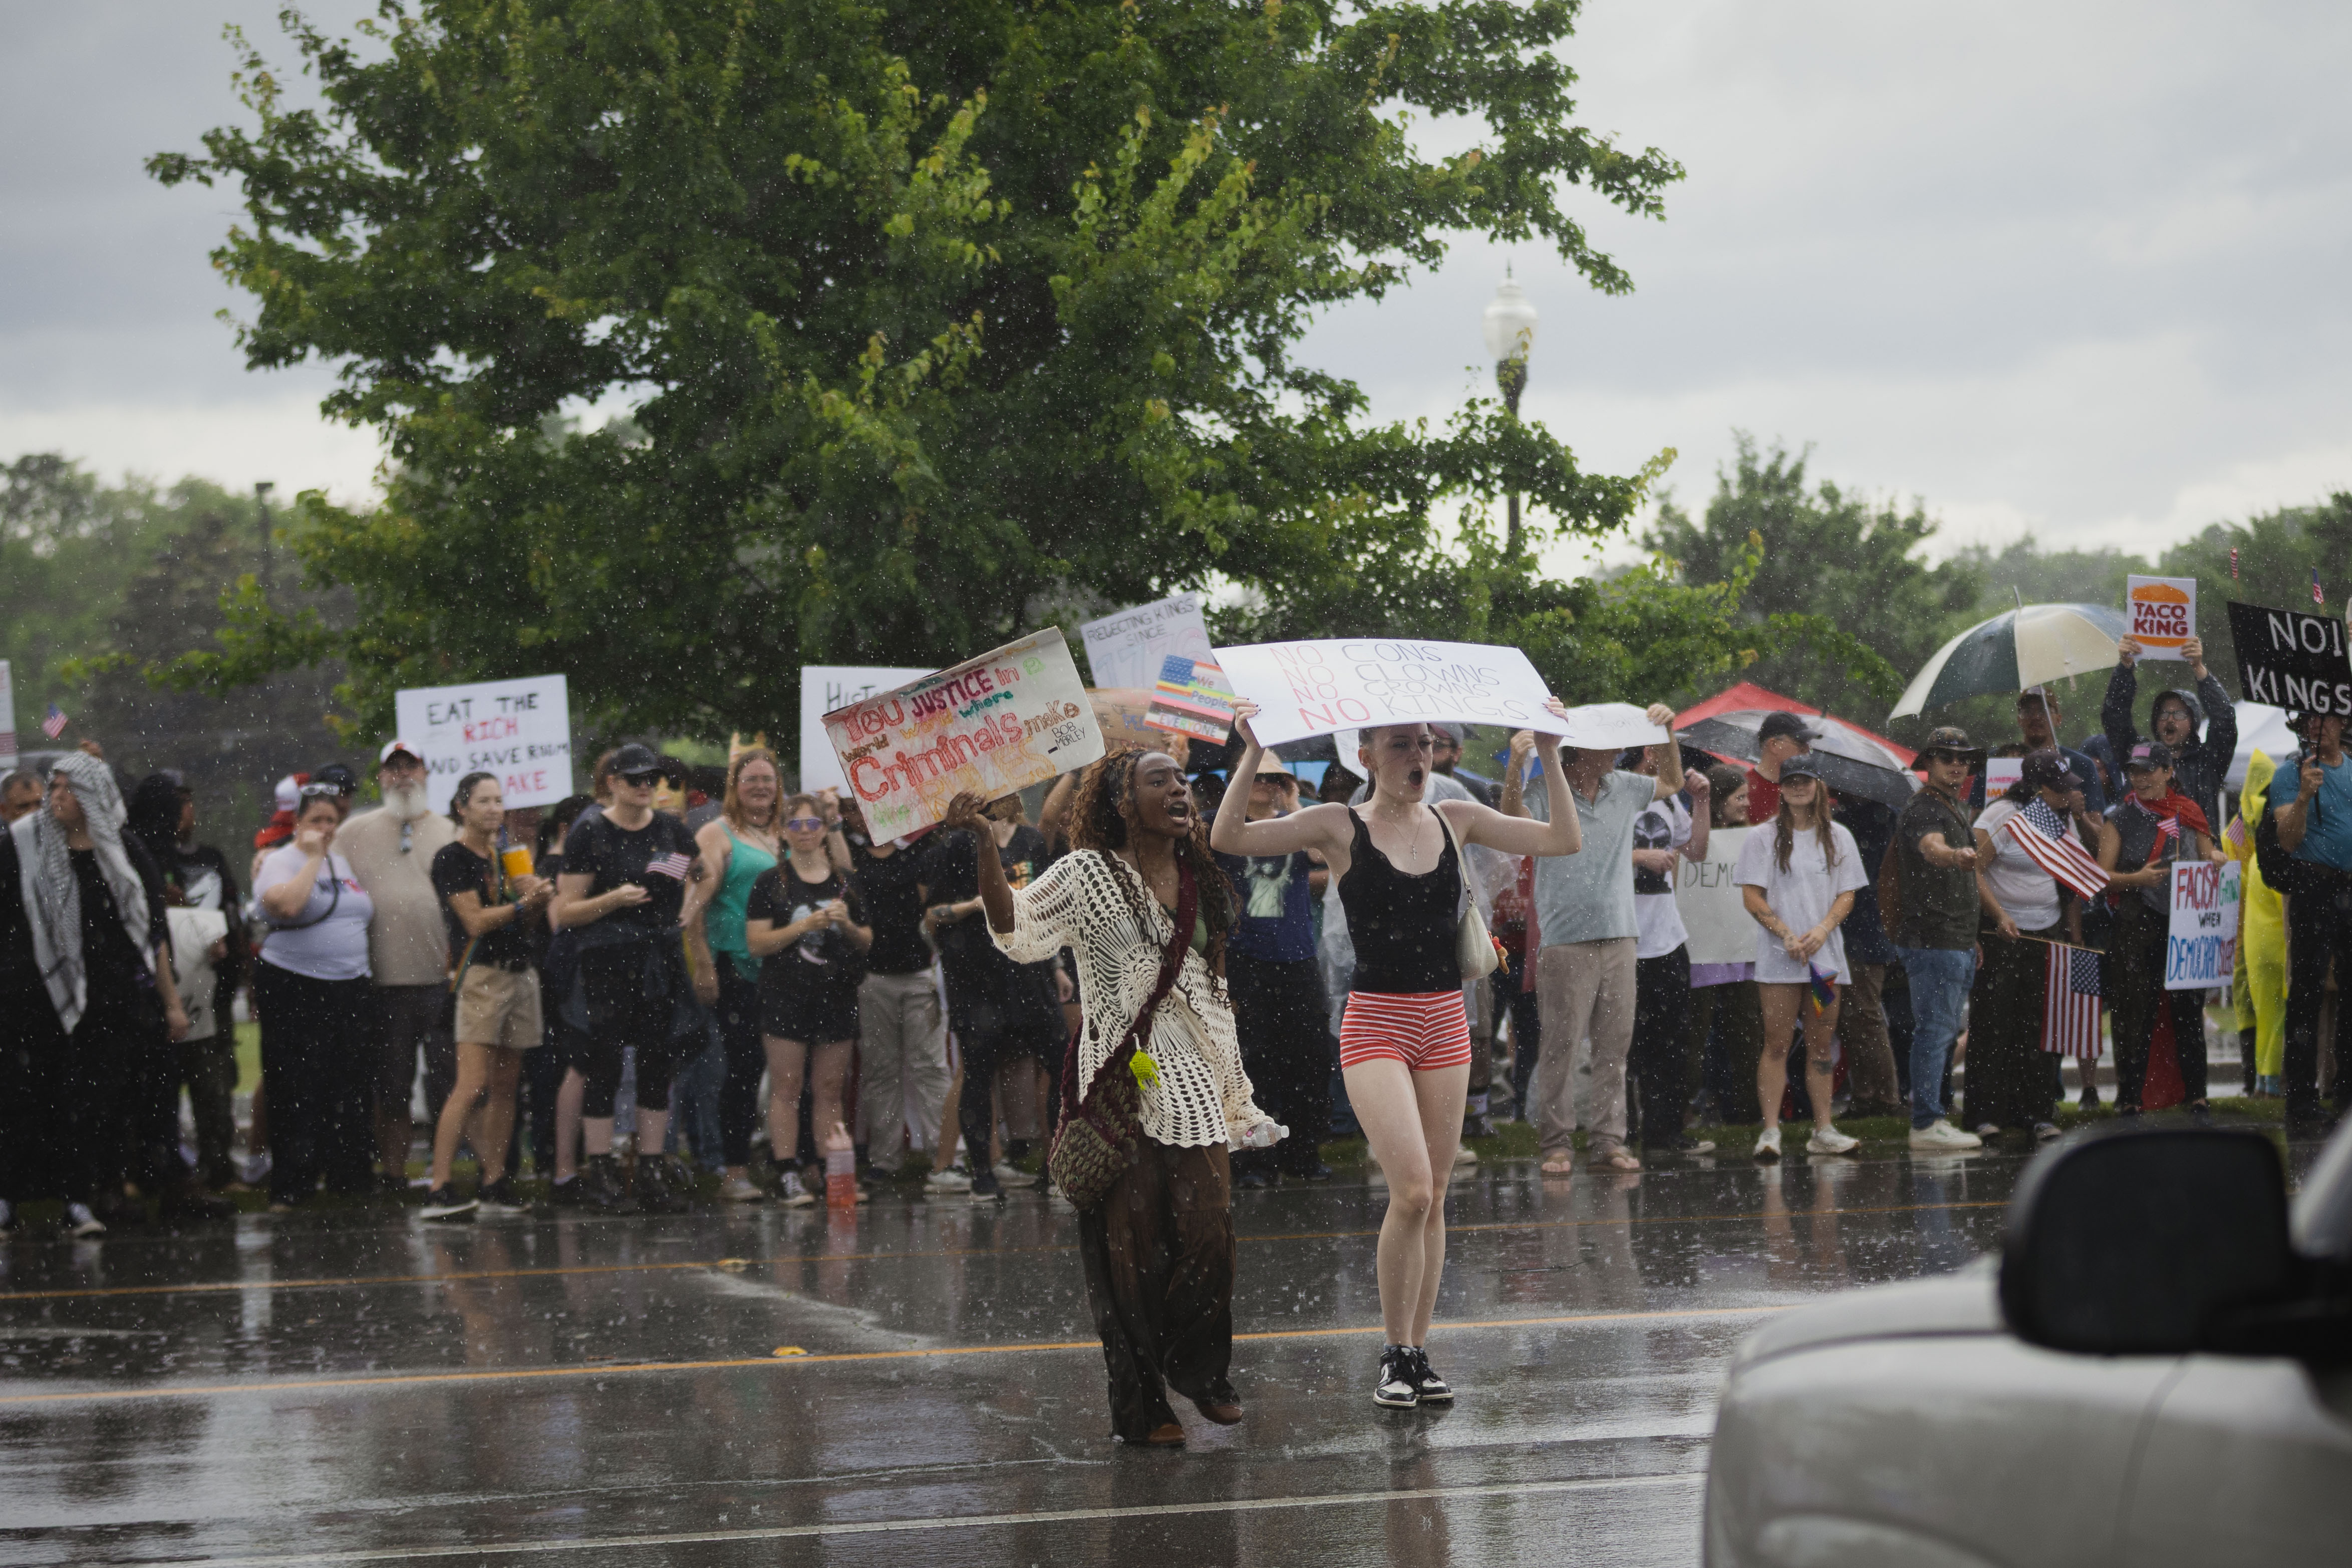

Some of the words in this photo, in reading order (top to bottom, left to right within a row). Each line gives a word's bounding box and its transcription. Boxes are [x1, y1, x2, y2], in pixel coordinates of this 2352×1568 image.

[1154, 598, 1195, 621] KINGS
[2133, 602, 2187, 620] TACO
[1126, 624, 1165, 647] SINCE
[2133, 618, 2188, 637] KING
[2268, 612, 2342, 657] NO!
[1269, 645, 1324, 668] NO
[1341, 643, 1442, 663] CONS
[1196, 676, 1214, 689] We
[1283, 665, 1335, 688] NO
[1355, 663, 1501, 686] CLOWNS
[912, 668, 994, 718] JUSTICE
[1190, 690, 1228, 709] People
[1292, 684, 1338, 704] NO
[1362, 680, 1492, 698] CROWNS
[2247, 665, 2352, 715] KINGS
[427, 699, 472, 725] EAT
[495, 693, 538, 712] THE
[958, 691, 1013, 718] where
[1298, 697, 1371, 731] NO
[1386, 694, 1530, 721] KINGS
[464, 717, 517, 743] RICH
[1052, 722, 1077, 738] BOB
[1158, 712, 1219, 738] EVERYONE
[469, 747, 522, 770] SAVE
[850, 713, 1023, 803] Criminals
[1024, 700, 1081, 736] make
[504, 770, 547, 797] AKE
[2176, 863, 2219, 911] FACISM
[2198, 912, 2221, 929] WHEN
